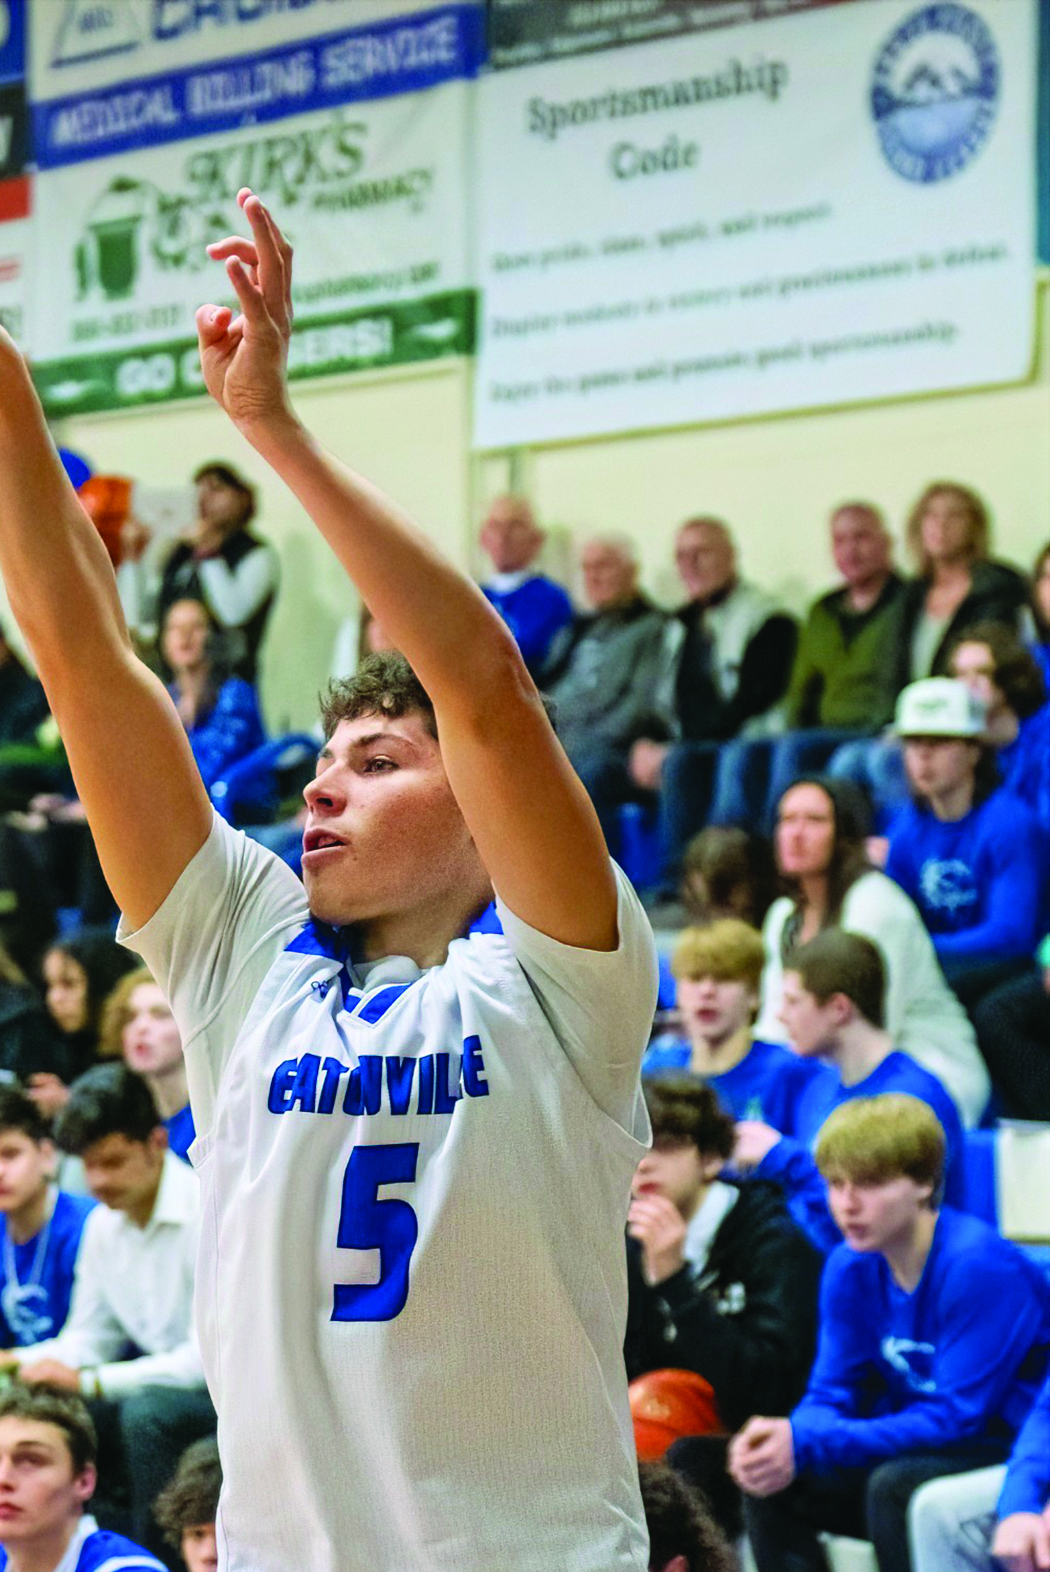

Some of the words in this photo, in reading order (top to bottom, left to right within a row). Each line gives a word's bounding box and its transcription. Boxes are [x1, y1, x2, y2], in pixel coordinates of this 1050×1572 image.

[51, 86, 179, 147] MEDICAL
[184, 51, 316, 117] BILLING
[319, 14, 460, 90] SERVICE
[528, 54, 789, 140] Sportsmanship
[611, 133, 701, 182] Code
[116, 352, 177, 396] GO
[330, 1142, 420, 1322] 5
